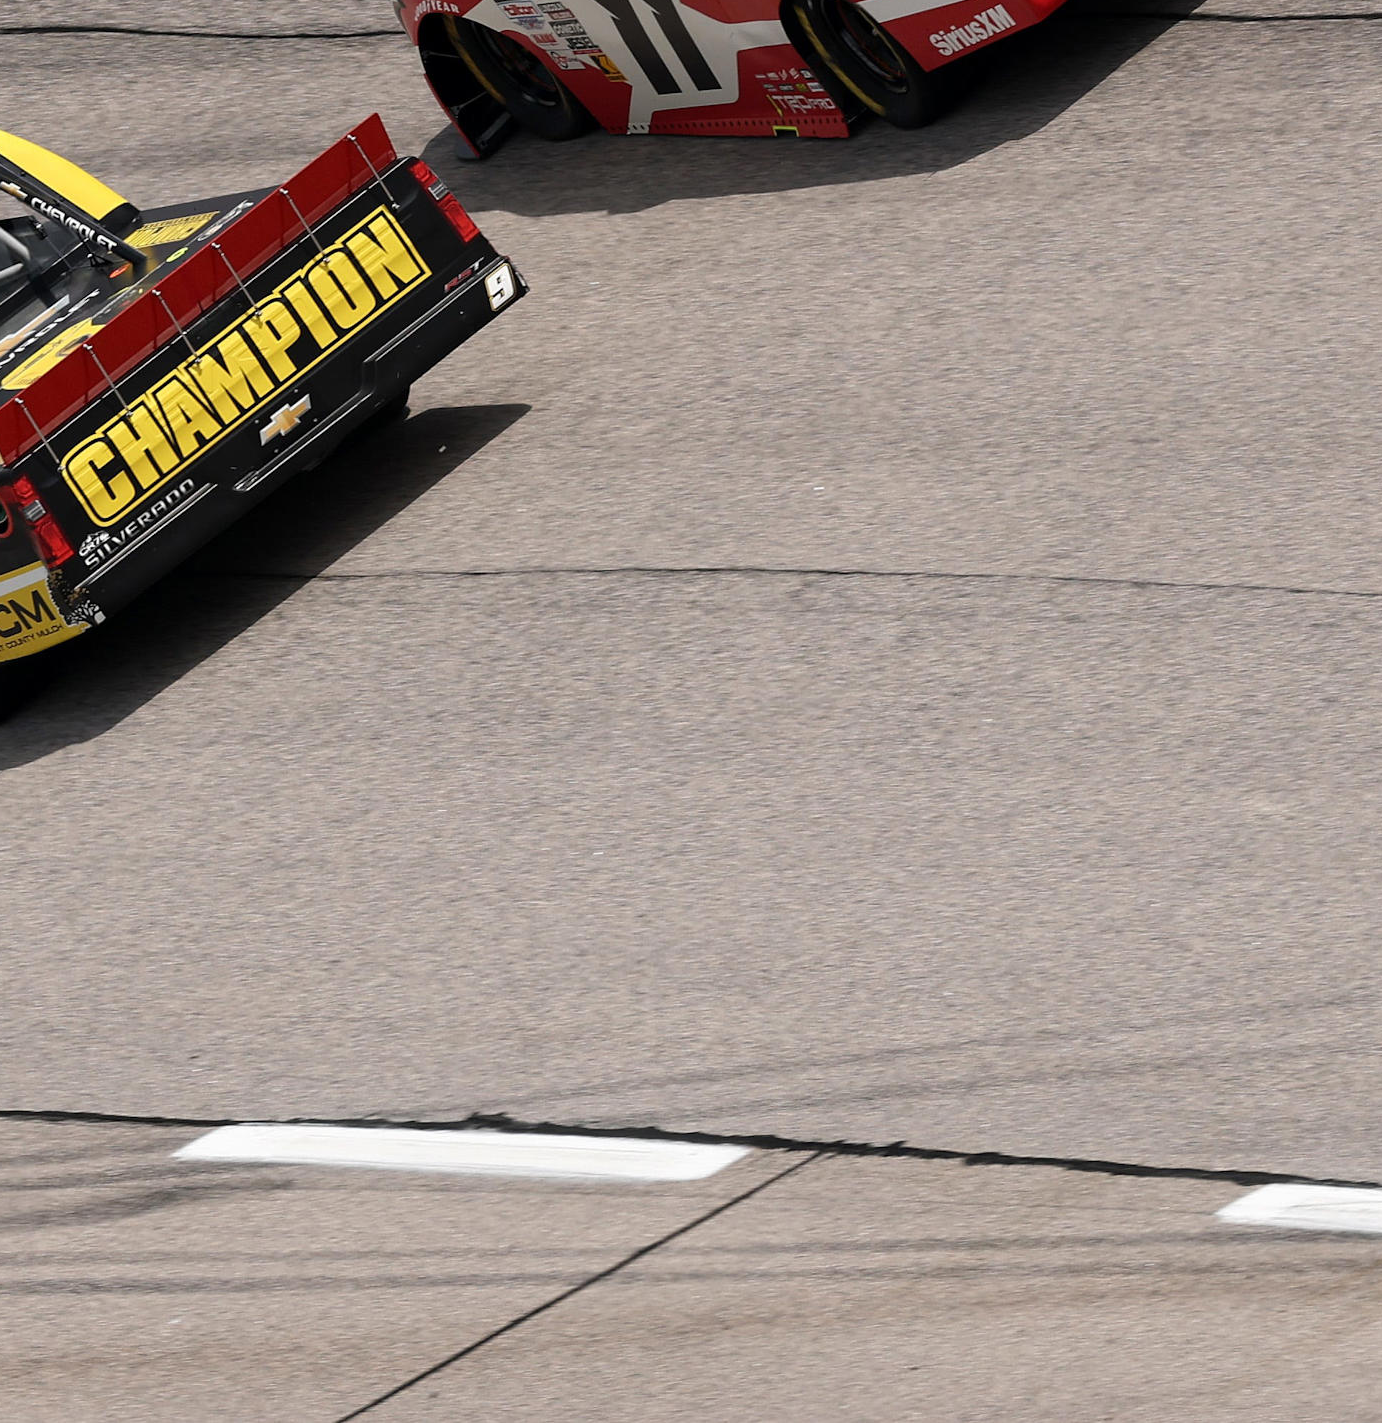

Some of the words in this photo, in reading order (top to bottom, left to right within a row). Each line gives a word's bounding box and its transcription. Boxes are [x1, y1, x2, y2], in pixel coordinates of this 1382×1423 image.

[928, 3, 1017, 57] SiriusXM
[30, 196, 118, 252] CHEVROLET
[485, 264, 515, 310] 9
[69, 212, 427, 523] CHAMPION
[83, 478, 196, 570] SILVERADO
[4, 632, 38, 650] COUNTY
[35, 623, 64, 640] MULCH
